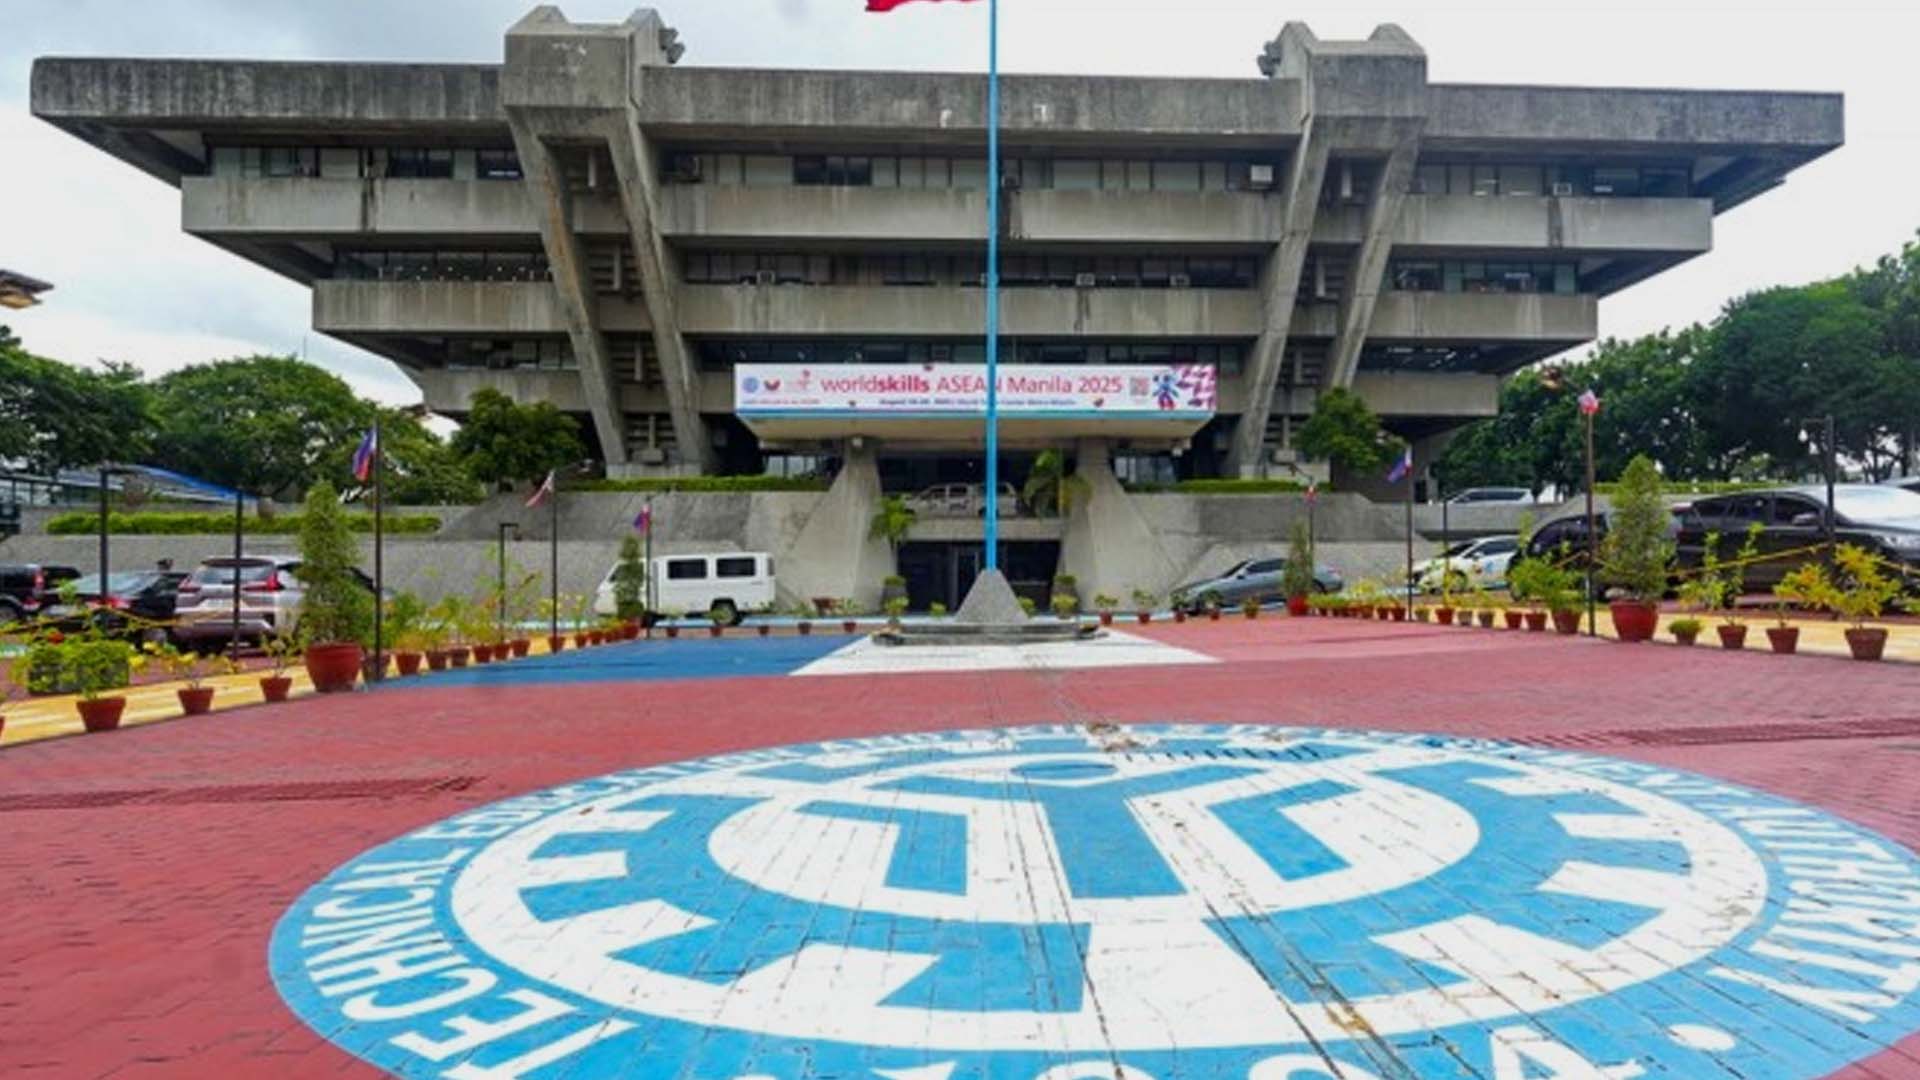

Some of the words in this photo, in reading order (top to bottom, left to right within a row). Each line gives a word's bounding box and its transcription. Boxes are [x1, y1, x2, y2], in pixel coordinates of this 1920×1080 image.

[820, 375, 930, 393] worldskills
[1007, 376, 1073, 393] Manila
[1078, 376, 1123, 393] 2025
[301, 848, 641, 1080] TECHNICAL
